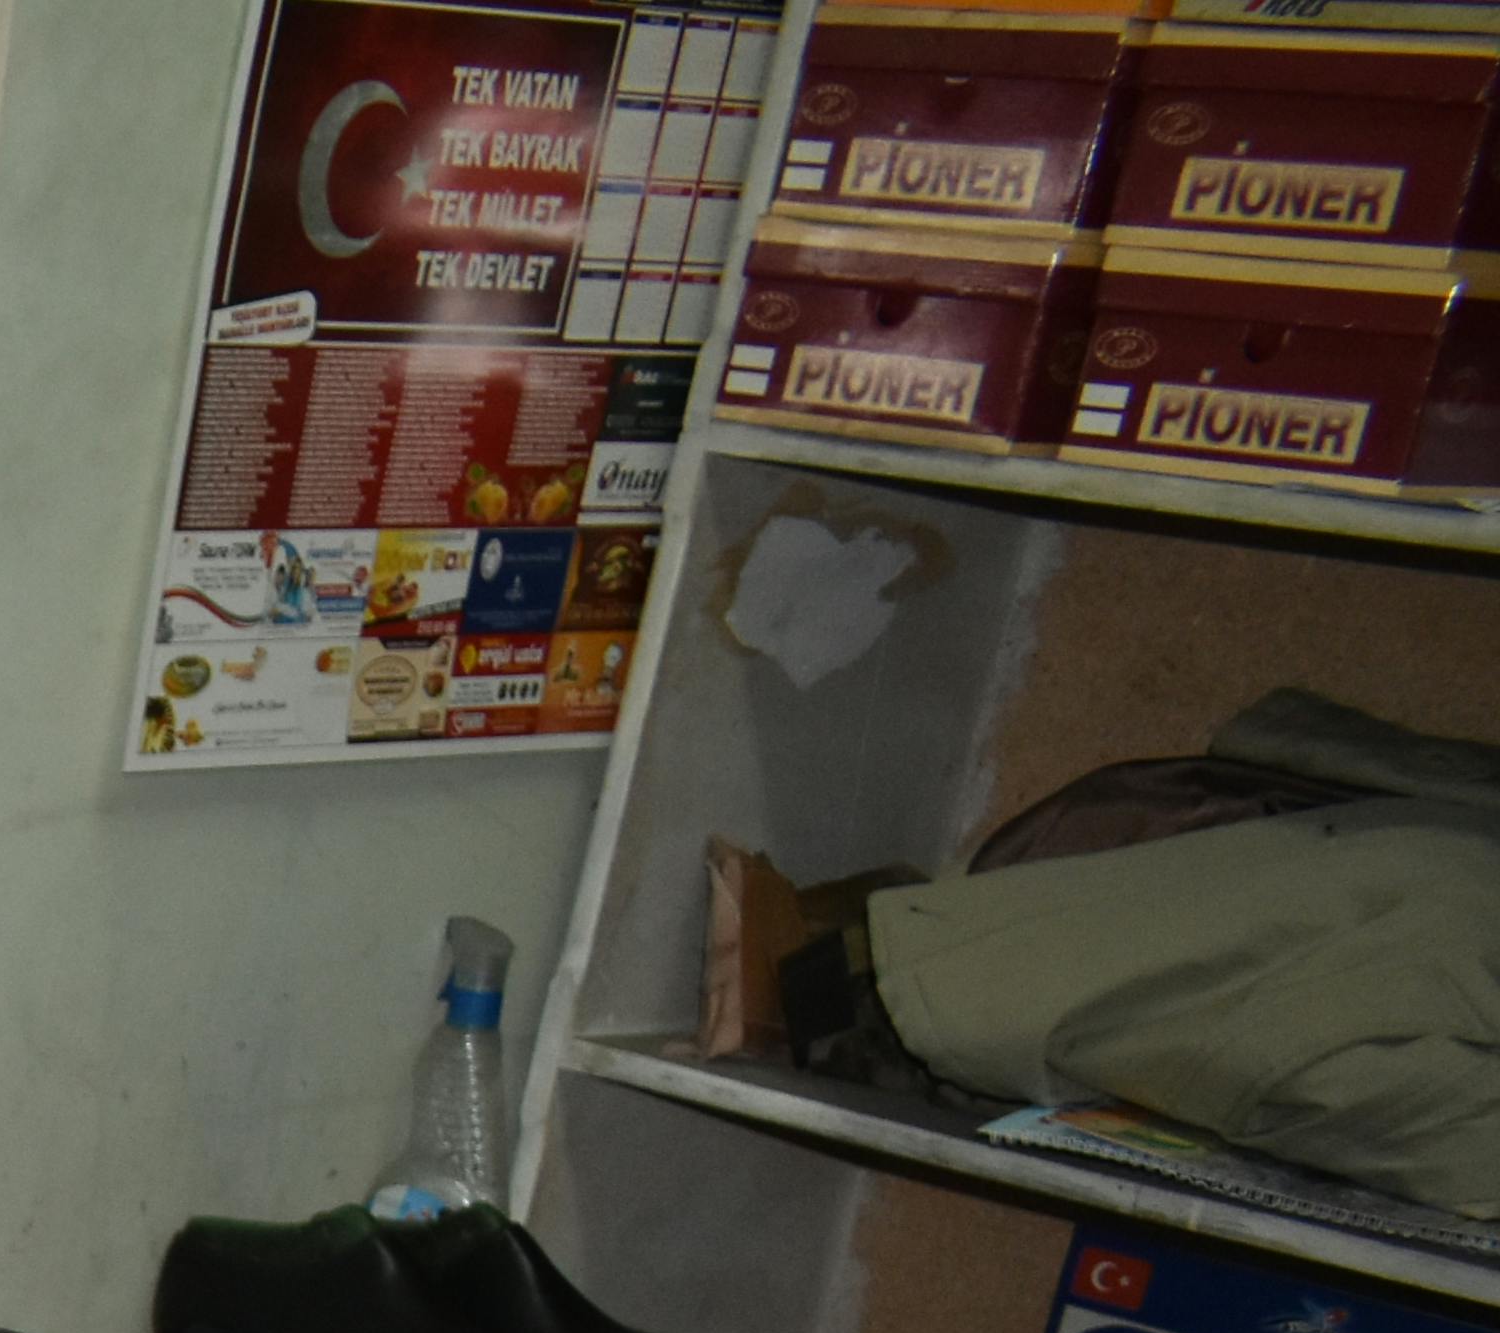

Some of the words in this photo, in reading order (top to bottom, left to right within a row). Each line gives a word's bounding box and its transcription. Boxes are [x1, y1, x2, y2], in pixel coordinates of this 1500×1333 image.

[453, 66, 499, 105] TEK
[504, 70, 580, 110] VATAN
[441, 128, 486, 167] TEK
[490, 132, 585, 173] BAYRAK
[428, 190, 474, 227] TEK
[477, 188, 564, 228] MİLLET
[416, 250, 460, 287] TEK
[465, 252, 555, 291] DEVLET
